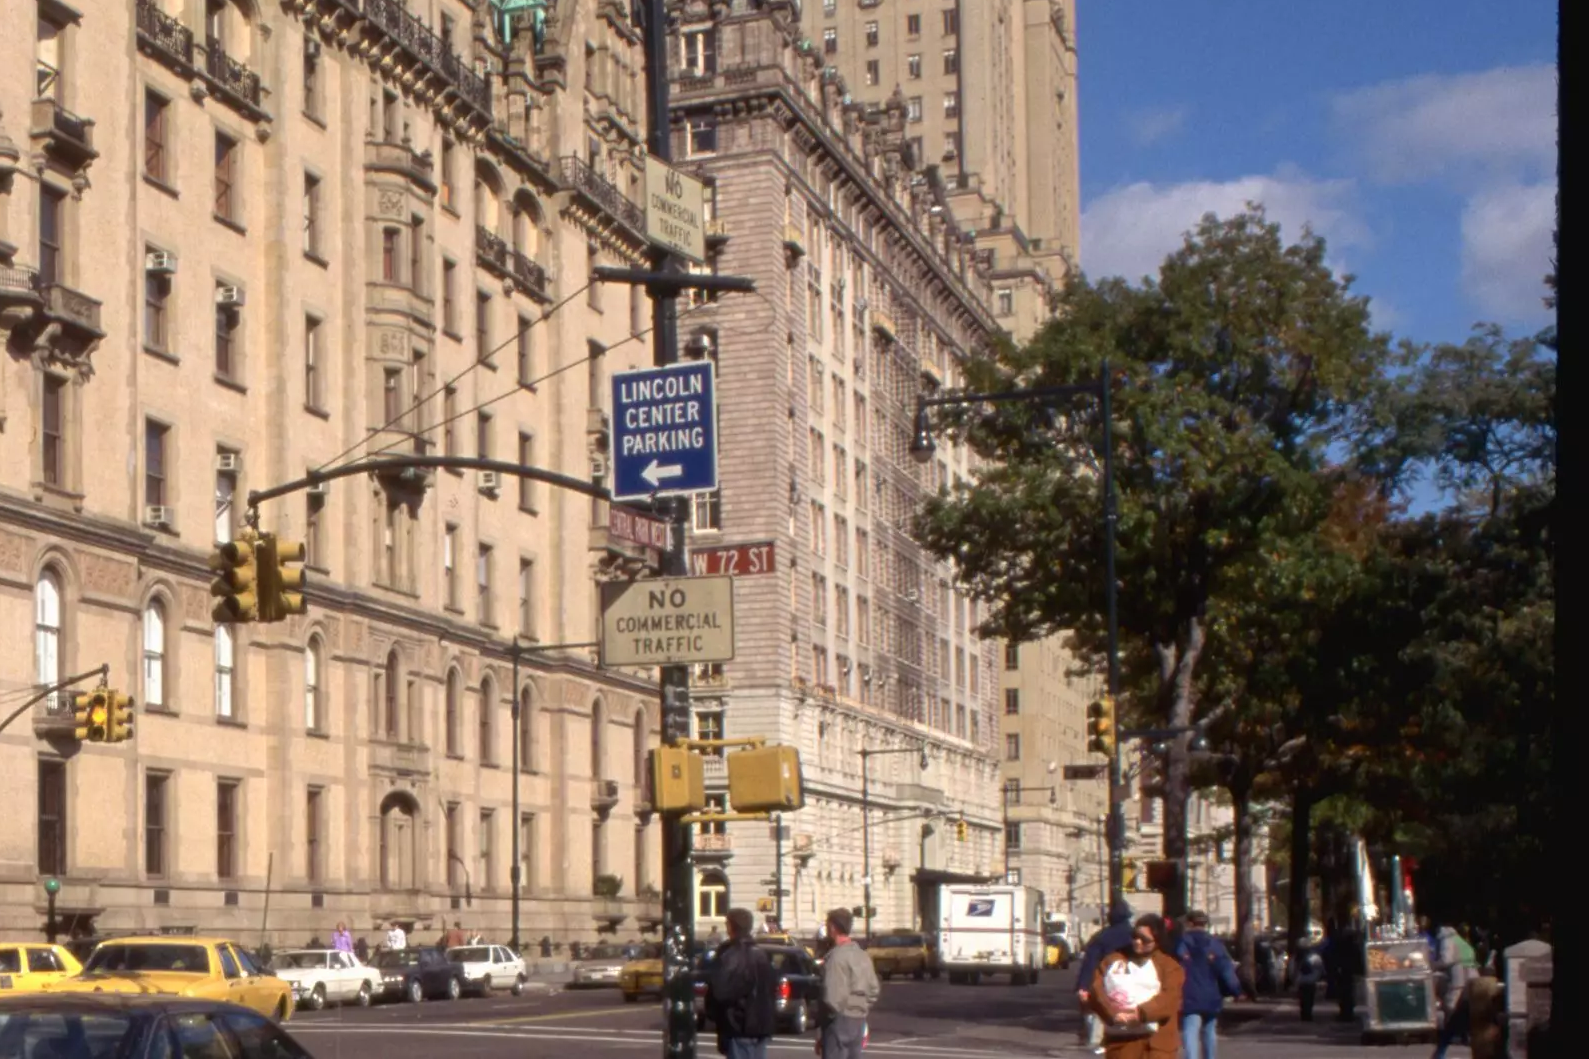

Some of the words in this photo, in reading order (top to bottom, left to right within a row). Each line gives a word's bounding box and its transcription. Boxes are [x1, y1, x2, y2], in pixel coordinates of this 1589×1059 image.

[665, 172, 682, 199] NO
[659, 217, 692, 247] TRAFFIC
[621, 373, 702, 403] LINCOLN
[625, 401, 699, 429] CENTER
[622, 427, 703, 456] PARKING
[693, 553, 708, 576] W
[716, 549, 740, 575] 72
[748, 547, 770, 573] ST
[649, 589, 686, 610] NO
[616, 612, 720, 634] COMMERCIAL
[633, 635, 703, 655] TRAFFIC
